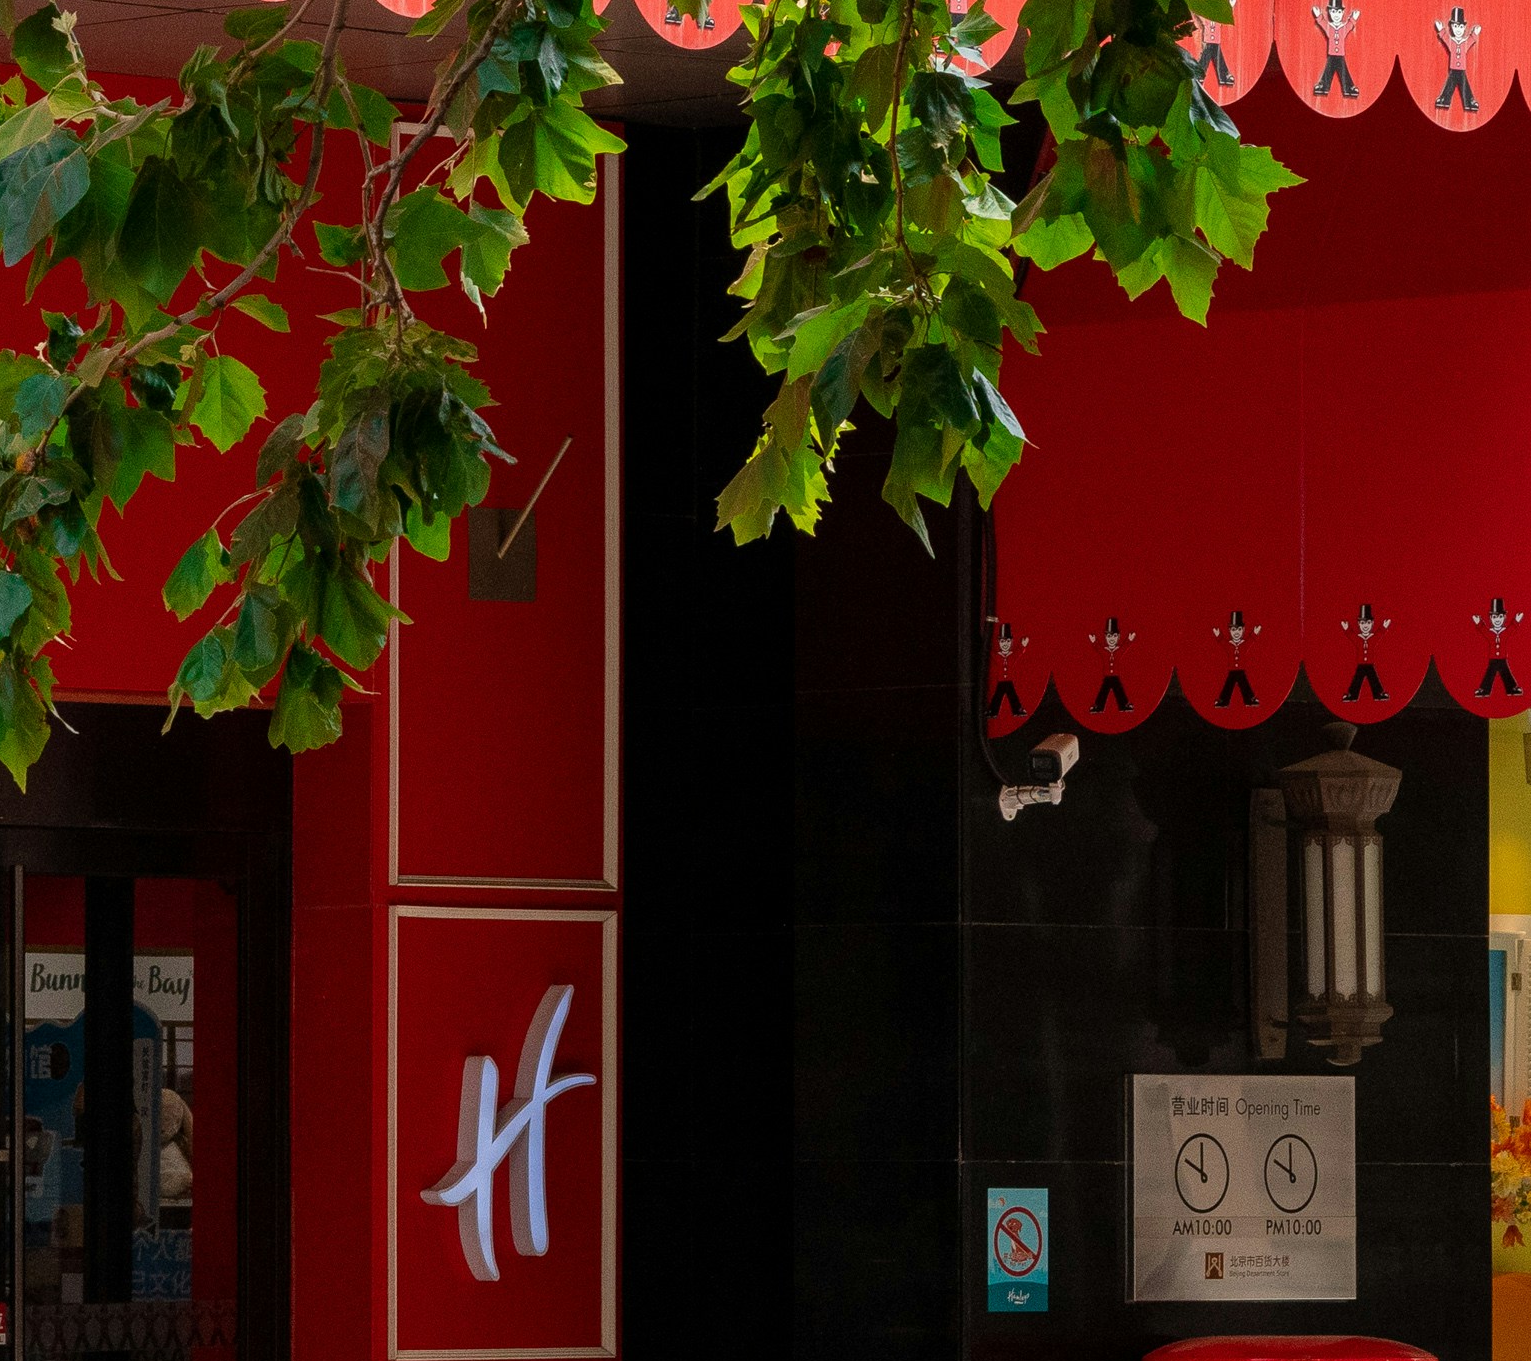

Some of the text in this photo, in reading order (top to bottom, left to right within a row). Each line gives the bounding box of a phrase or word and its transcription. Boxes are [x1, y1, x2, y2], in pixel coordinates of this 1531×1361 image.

[30, 963, 86, 993] Bunn
[148, 965, 190, 1006] Bay
[1171, 1096, 1321, 1121] 营业时间 Opening Time
[420, 984, 597, 1282] H
[1173, 1219, 1322, 1236] AM10:00 PM10:00
[1230, 1255, 1290, 1268] 北京市百货大楼
